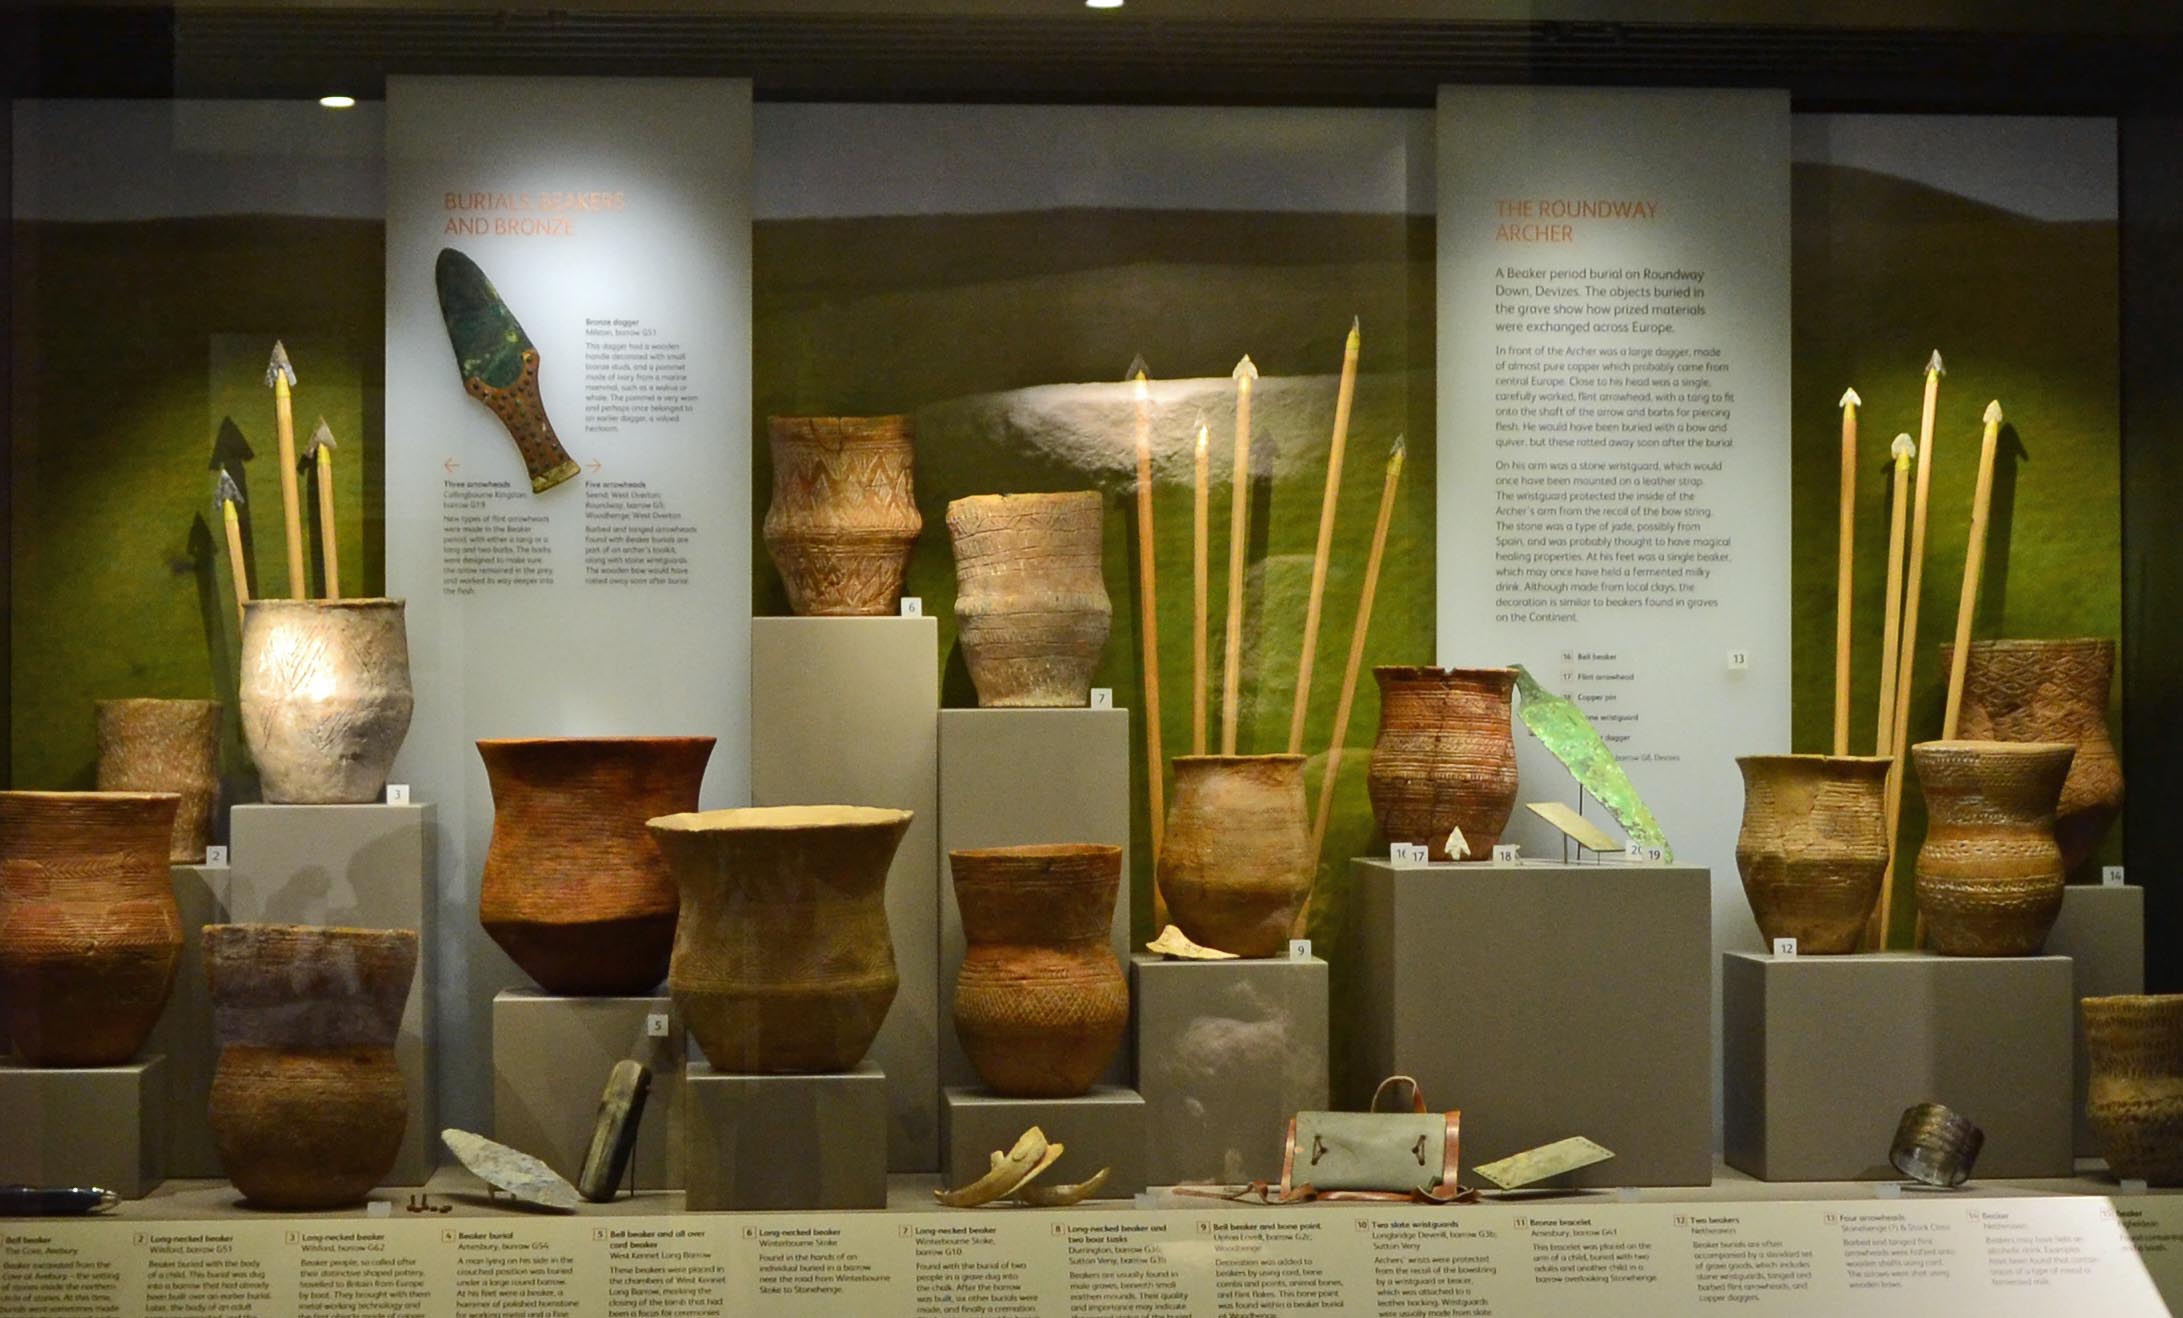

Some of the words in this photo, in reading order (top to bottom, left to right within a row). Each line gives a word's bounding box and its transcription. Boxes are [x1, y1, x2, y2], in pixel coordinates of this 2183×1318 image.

[1495, 200, 1535, 218] THE
[1539, 200, 1659, 218] ROUNDWAY
[444, 217, 490, 235] AND
[492, 217, 575, 235] BRONZE
[1495, 224, 1574, 241] ARCHER
[1495, 267, 1505, 279] A
[1506, 268, 1546, 279] Beaker
[1549, 268, 1589, 282] period
[1588, 268, 1623, 280] burial
[1625, 271, 1641, 280] on
[1642, 269, 1704, 283] Roundway
[1495, 286, 1530, 298] Down,
[1535, 286, 1579, 297] Devizes.
[1585, 286, 1607, 297] The
[1609, 286, 1651, 300] objects
[1654, 286, 1693, 297] buried
[1693, 286, 1704, 298] in
[1495, 303, 1515, 314] the
[1518, 306, 1551, 317] grave
[1553, 303, 1584, 315] show
[1586, 304, 1611, 315] how
[1614, 304, 1651, 318] prized
[1652, 304, 1706, 315] materials
[585, 318, 612, 326] Bronze
[613, 318, 640, 328] dagger
[1495, 324, 1524, 332] were
[1526, 322, 1591, 335] exchanged
[1593, 325, 1629, 333] across
[1632, 322, 1675, 335] Europe.
[1495, 347, 1508, 356] In
[1507, 347, 1532, 356] front
[1533, 347, 1547, 356] of
[1546, 347, 1564, 356] the
[1565, 347, 1597, 356] Archer
[1627, 347, 1653, 359] large
[1693, 348, 1721, 357] made
[1495, 362, 1506, 371] of
[1508, 362, 1541, 371] almost
[1543, 364, 1565, 373] pure
[1567, 364, 1600, 373] copper
[1602, 362, 1632, 371] which
[1631, 362, 1677, 374] probably
[1704, 363, 1729, 372] from
[1495, 377, 1531, 386] central
[1568, 377, 1595, 386] Close
[1595, 377, 1608, 386] to
[1608, 377, 1625, 386] his
[1624, 377, 1651, 386] head
[1495, 392, 1537, 403] carefully
[1574, 392, 1597, 401] flint
[1655, 393, 1678, 402] with
[1686, 393, 1711, 404] tang
[1710, 393, 1724, 402] to
[1723, 393, 1735, 402] fit
[908, 603, 915, 613] 6
[1509, 613, 1527, 622] the
[1733, 654, 1745, 664] 13
[1099, 693, 1105, 704] 7
[1578, 694, 1603, 702] Copper
[1605, 734, 1631, 742] dagger
[394, 790, 401, 800] 3
[213, 851, 220, 861] 2
[1413, 851, 1425, 862] 17
[1500, 851, 1511, 862] 18
[1649, 850, 1661, 860] 19
[1297, 945, 1305, 956] 9
[1781, 944, 1793, 954] 12
[655, 1020, 663, 1031] 5
[1372, 1221, 1389, 1229] Two
[1412, 1220, 1459, 1230] wristguards
[1530, 1218, 1558, 1226] Bronze
[1559, 1218, 1592, 1226] bracelet
[1690, 1216, 1708, 1225] Two
[1708, 1216, 1740, 1224] beakers
[903, 1227, 909, 1235] 7
[915, 1226, 968, 1236] Long-necked
[968, 1226, 997, 1234] beaker
[1068, 1225, 1120, 1234] Long-necked
[1121, 1224, 1149, 1232] beaker
[1150, 1224, 1167, 1232] and
[1259, 1222, 1276, 1230] and
[1277, 1222, 1298, 1230] bone
[355, 1233, 385, 1241] beaker
[458, 1232, 487, 1240] Beaker
[489, 1232, 514, 1240] burial
[598, 1230, 604, 1238] 5
[626, 1230, 656, 1238] beaker
[657, 1230, 675, 1238] and
[759, 1228, 812, 1238] Long-necked
[812, 1228, 842, 1236] beaker
[22, 1235, 51, 1244] beaker
[138, 1235, 144, 1243] 2
[204, 1235, 233, 1243] beaker
[630, 1241, 658, 1249] beaker
